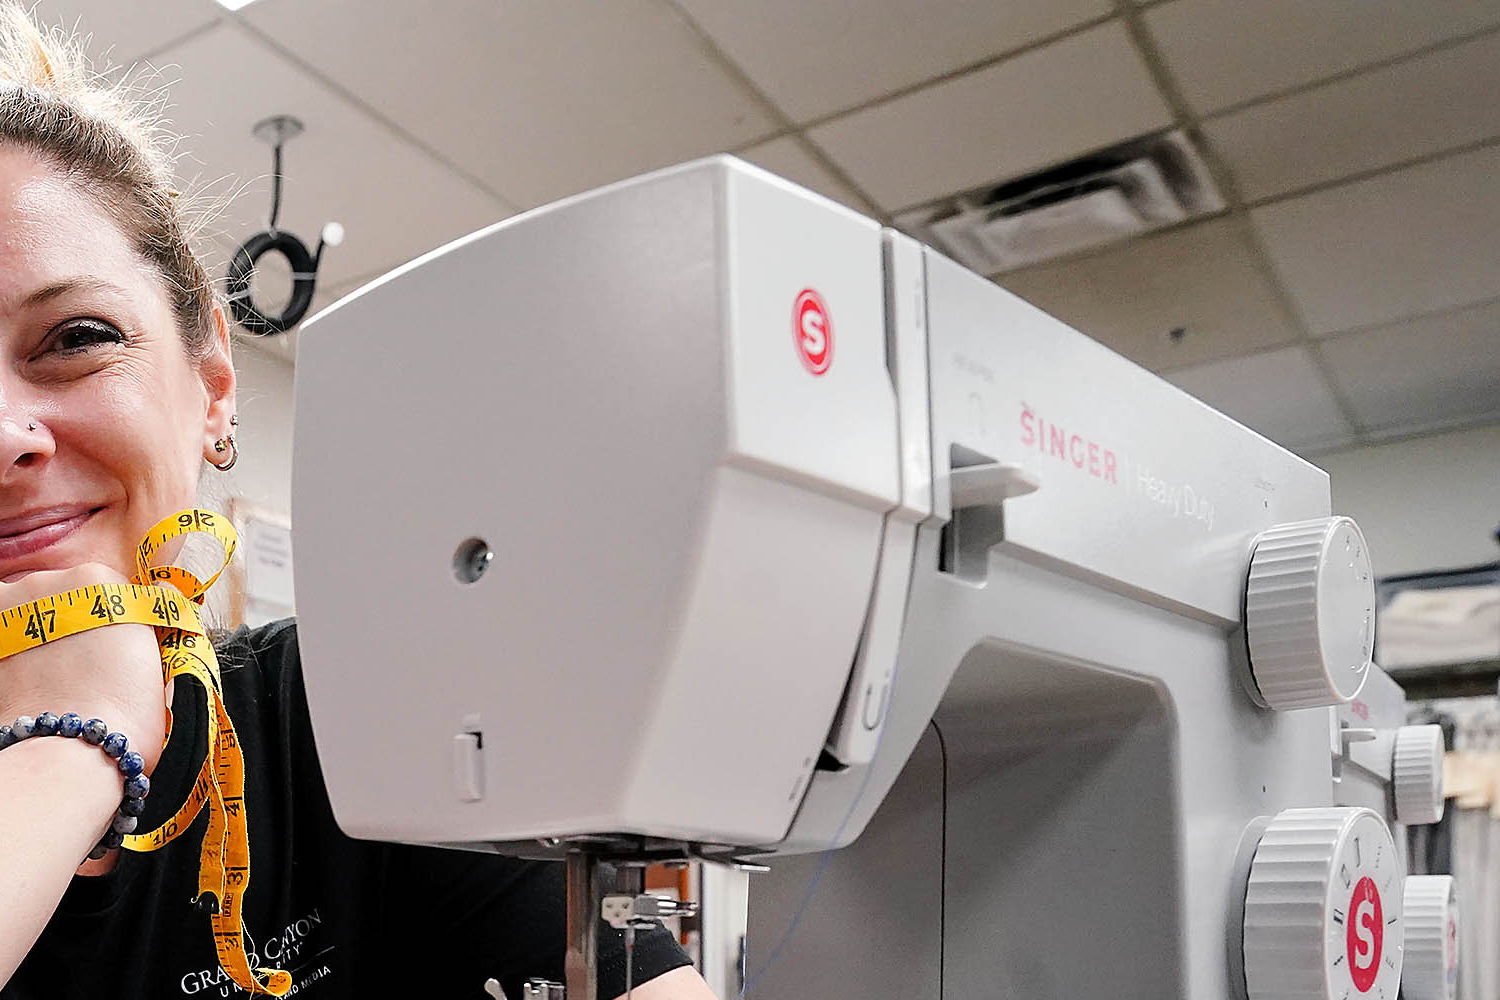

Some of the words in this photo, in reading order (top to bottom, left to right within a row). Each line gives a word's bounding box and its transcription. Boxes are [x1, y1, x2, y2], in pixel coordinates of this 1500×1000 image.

[1020, 408, 1118, 485] SINGER
[25, 609, 56, 640] 47
[91, 594, 126, 620] 48
[152, 597, 180, 622] 49
[160, 632, 197, 649] 46
[224, 801, 240, 817] 4
[153, 822, 178, 846] 10
[226, 872, 244, 886] 3
[181, 952, 260, 995] GRAD
[301, 965, 332, 990] MEDIA
